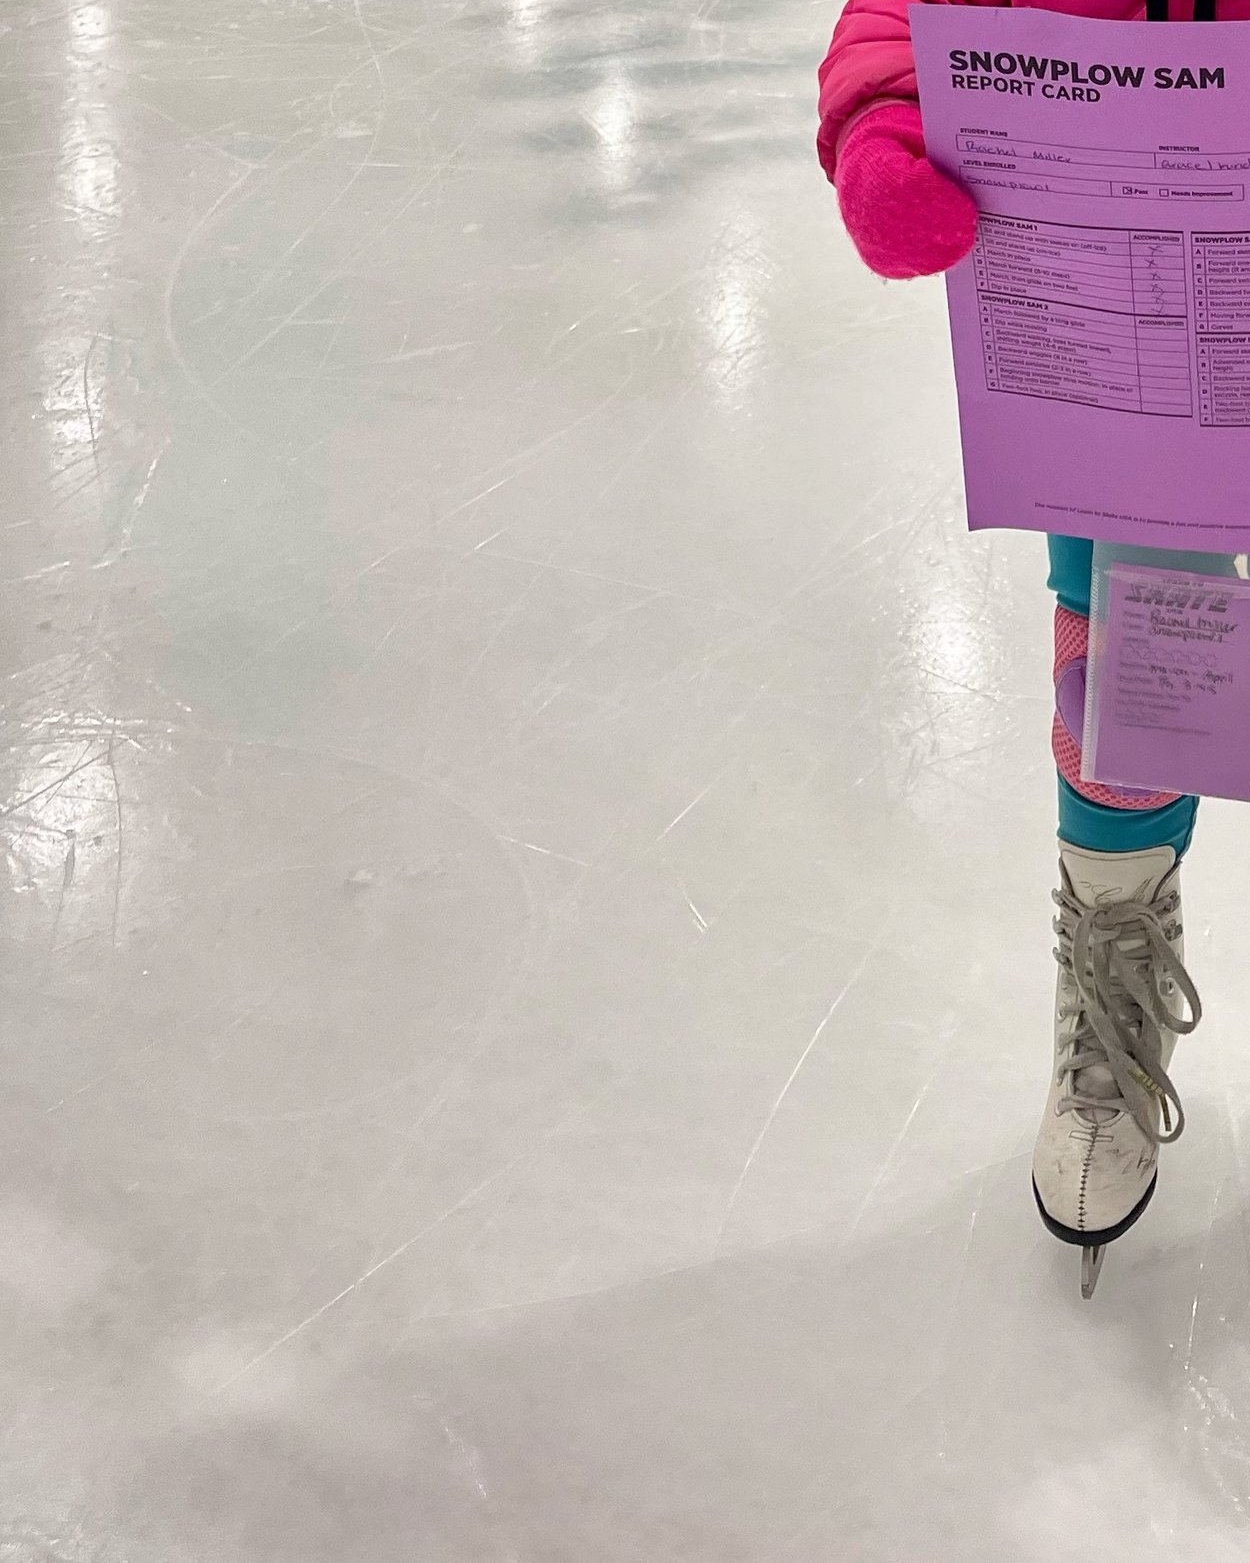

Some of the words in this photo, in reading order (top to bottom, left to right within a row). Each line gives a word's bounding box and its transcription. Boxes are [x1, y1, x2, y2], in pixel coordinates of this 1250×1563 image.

[950, 50, 1145, 88] SNOWPLOW
[1154, 68, 1225, 89] SAM
[952, 74, 1035, 96] REPORT
[1042, 85, 1101, 102] CARD
[960, 128, 988, 136] STUDENT
[983, 162, 1016, 170] ENROLLED
[981, 295, 1025, 307] SNOWPLOW
[1027, 302, 1043, 310] SAM
